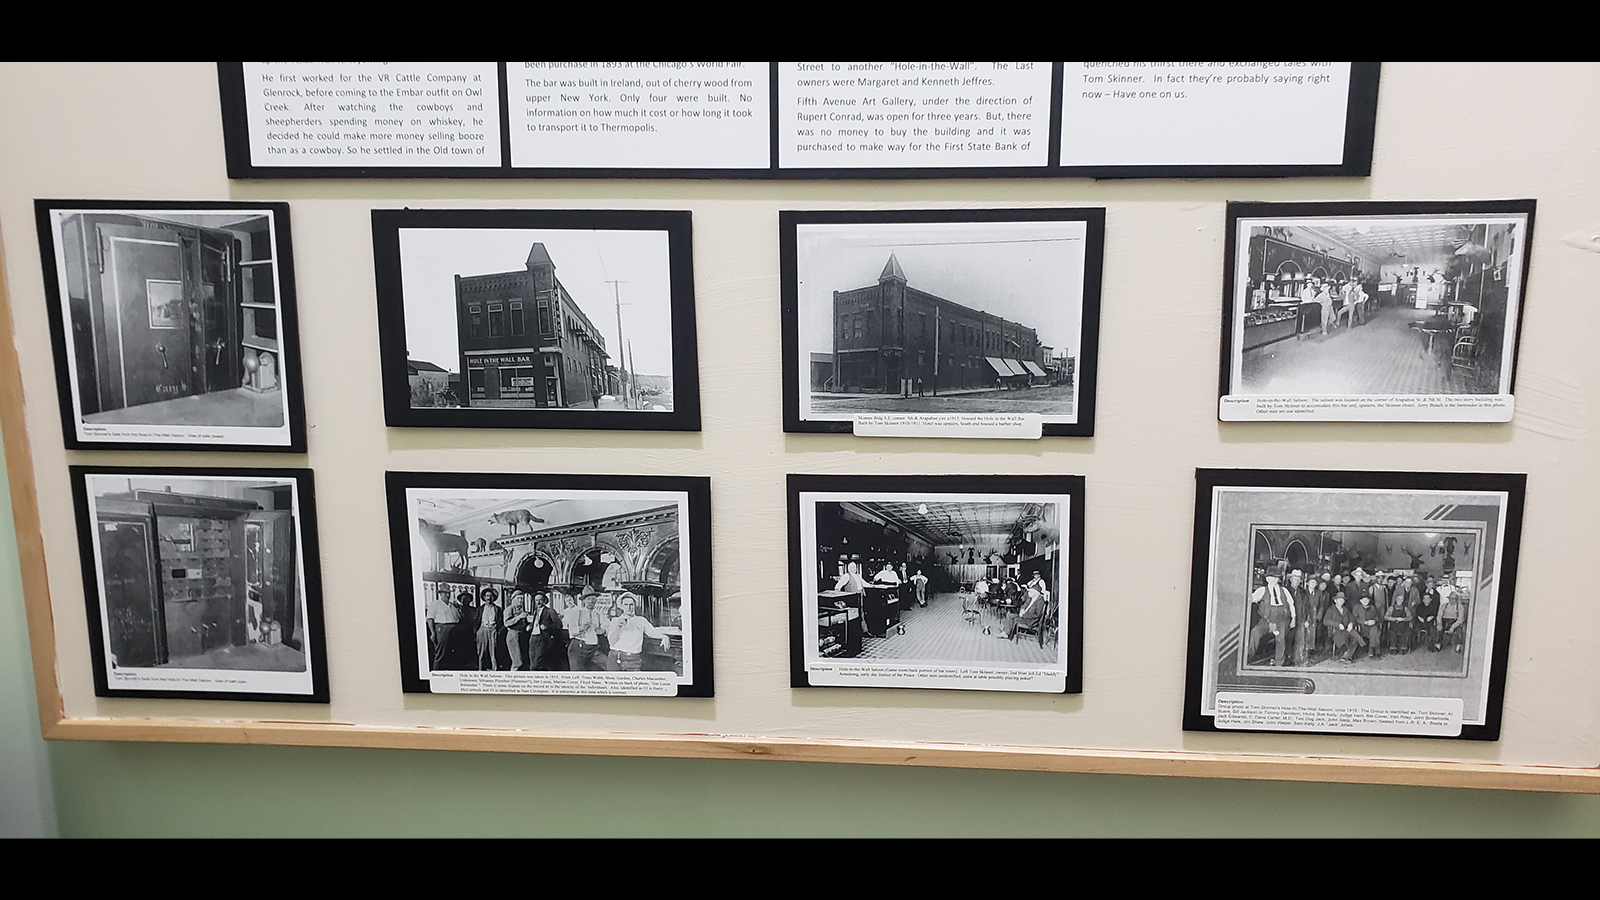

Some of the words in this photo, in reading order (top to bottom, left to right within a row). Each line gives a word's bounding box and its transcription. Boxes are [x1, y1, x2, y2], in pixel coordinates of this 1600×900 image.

[261, 73, 274, 83] He
[279, 73, 297, 83] first
[301, 73, 334, 83] worked
[339, 73, 352, 83] for
[357, 73, 373, 83] the
[377, 73, 391, 82] VR
[395, 73, 421, 83] Cattle
[426, 73, 467, 84] Company
[472, 74, 482, 82] at
[524, 78, 542, 88] The
[542, 78, 558, 88] bar
[578, 78, 599, 88] built
[600, 78, 609, 88] in
[610, 78, 644, 89] Ireland,
[645, 79, 661, 88] out
[662, 78, 672, 88] of
[673, 78, 702, 90] cherry
[703, 78, 729, 88] wood
[730, 77, 753, 88] from
[796, 79, 831, 87] owners
[832, 79, 856, 87] were
[857, 77, 900, 89] Margaret
[901, 76, 919, 87] and
[921, 76, 960, 87] Kenneth
[961, 76, 995, 86] Jeffres.
[1082, 74, 1104, 84] Tom
[1107, 73, 1146, 84] Skinner.
[1153, 74, 1163, 83] In
[1166, 73, 1185, 84] fact
[1226, 73, 1270, 85] probably
[1273, 73, 1304, 85] saying
[1307, 73, 1330, 85] right
[262, 88, 304, 98] Glenrock,
[304, 87, 334, 98] before
[335, 88, 367, 99] coming
[368, 89, 378, 97] to
[379, 88, 394, 97] the
[396, 87, 424, 97] Embar
[425, 87, 450, 97] outfit
[464, 87, 483, 97] Owl
[525, 95, 552, 104] upper
[560, 93, 581, 103] New
[588, 93, 611, 103] York.
[619, 93, 641, 104] Only
[649, 92, 668, 103] four
[707, 93, 731, 103] built.
[739, 93, 753, 103] No
[1112, 89, 1137, 99] Have
[797, 96, 818, 106] Fifth
[822, 97, 857, 106] Avenue
[861, 97, 876, 106] Art
[881, 96, 917, 108] Gallery,
[922, 96, 950, 106] under
[955, 96, 971, 106] the
[975, 96, 1017, 106] direction
[1022, 95, 1033, 106] of
[264, 102, 291, 112] Creek.
[303, 102, 325, 112] After
[337, 102, 377, 114] watching
[389, 102, 404, 112] the
[416, 102, 454, 113] cowboys
[466, 102, 483, 112] and
[526, 107, 578, 118] information
[579, 109, 591, 118] on
[593, 108, 613, 118] how
[614, 108, 639, 118] much
[640, 108, 647, 118] it
[648, 109, 667, 118] cost
[681, 108, 701, 118] how
[702, 108, 722, 120] long
[723, 108, 730, 118] it
[732, 108, 753, 118] took
[265, 116, 323, 128] sheepherders
[329, 117, 368, 128] spending
[374, 118, 404, 128] money
[428, 117, 466, 128] whiskey,
[472, 116, 484, 126] he
[797, 112, 828, 123] Rupert
[829, 111, 865, 123] Conrad,
[866, 113, 885, 122] was
[886, 113, 910, 123] open
[911, 111, 925, 121] for
[927, 111, 952, 121] three
[953, 113, 981, 123] years.
[985, 111, 1005, 122] But,
[1006, 111, 1032, 121] there
[526, 123, 537, 132] to
[538, 123, 579, 134] transport
[580, 122, 587, 132] it
[589, 123, 599, 132] to
[600, 122, 658, 134] Thermopolis.
[796, 142, 843, 153] purchased
[846, 143, 856, 152] to
[859, 142, 884, 152] make
[887, 144, 906, 153] way
[909, 141, 923, 152] for
[925, 142, 941, 152] the
[944, 142, 964, 151] First
[967, 141, 992, 151] State
[994, 141, 1018, 151] Bank
[1020, 141, 1032, 151] of
